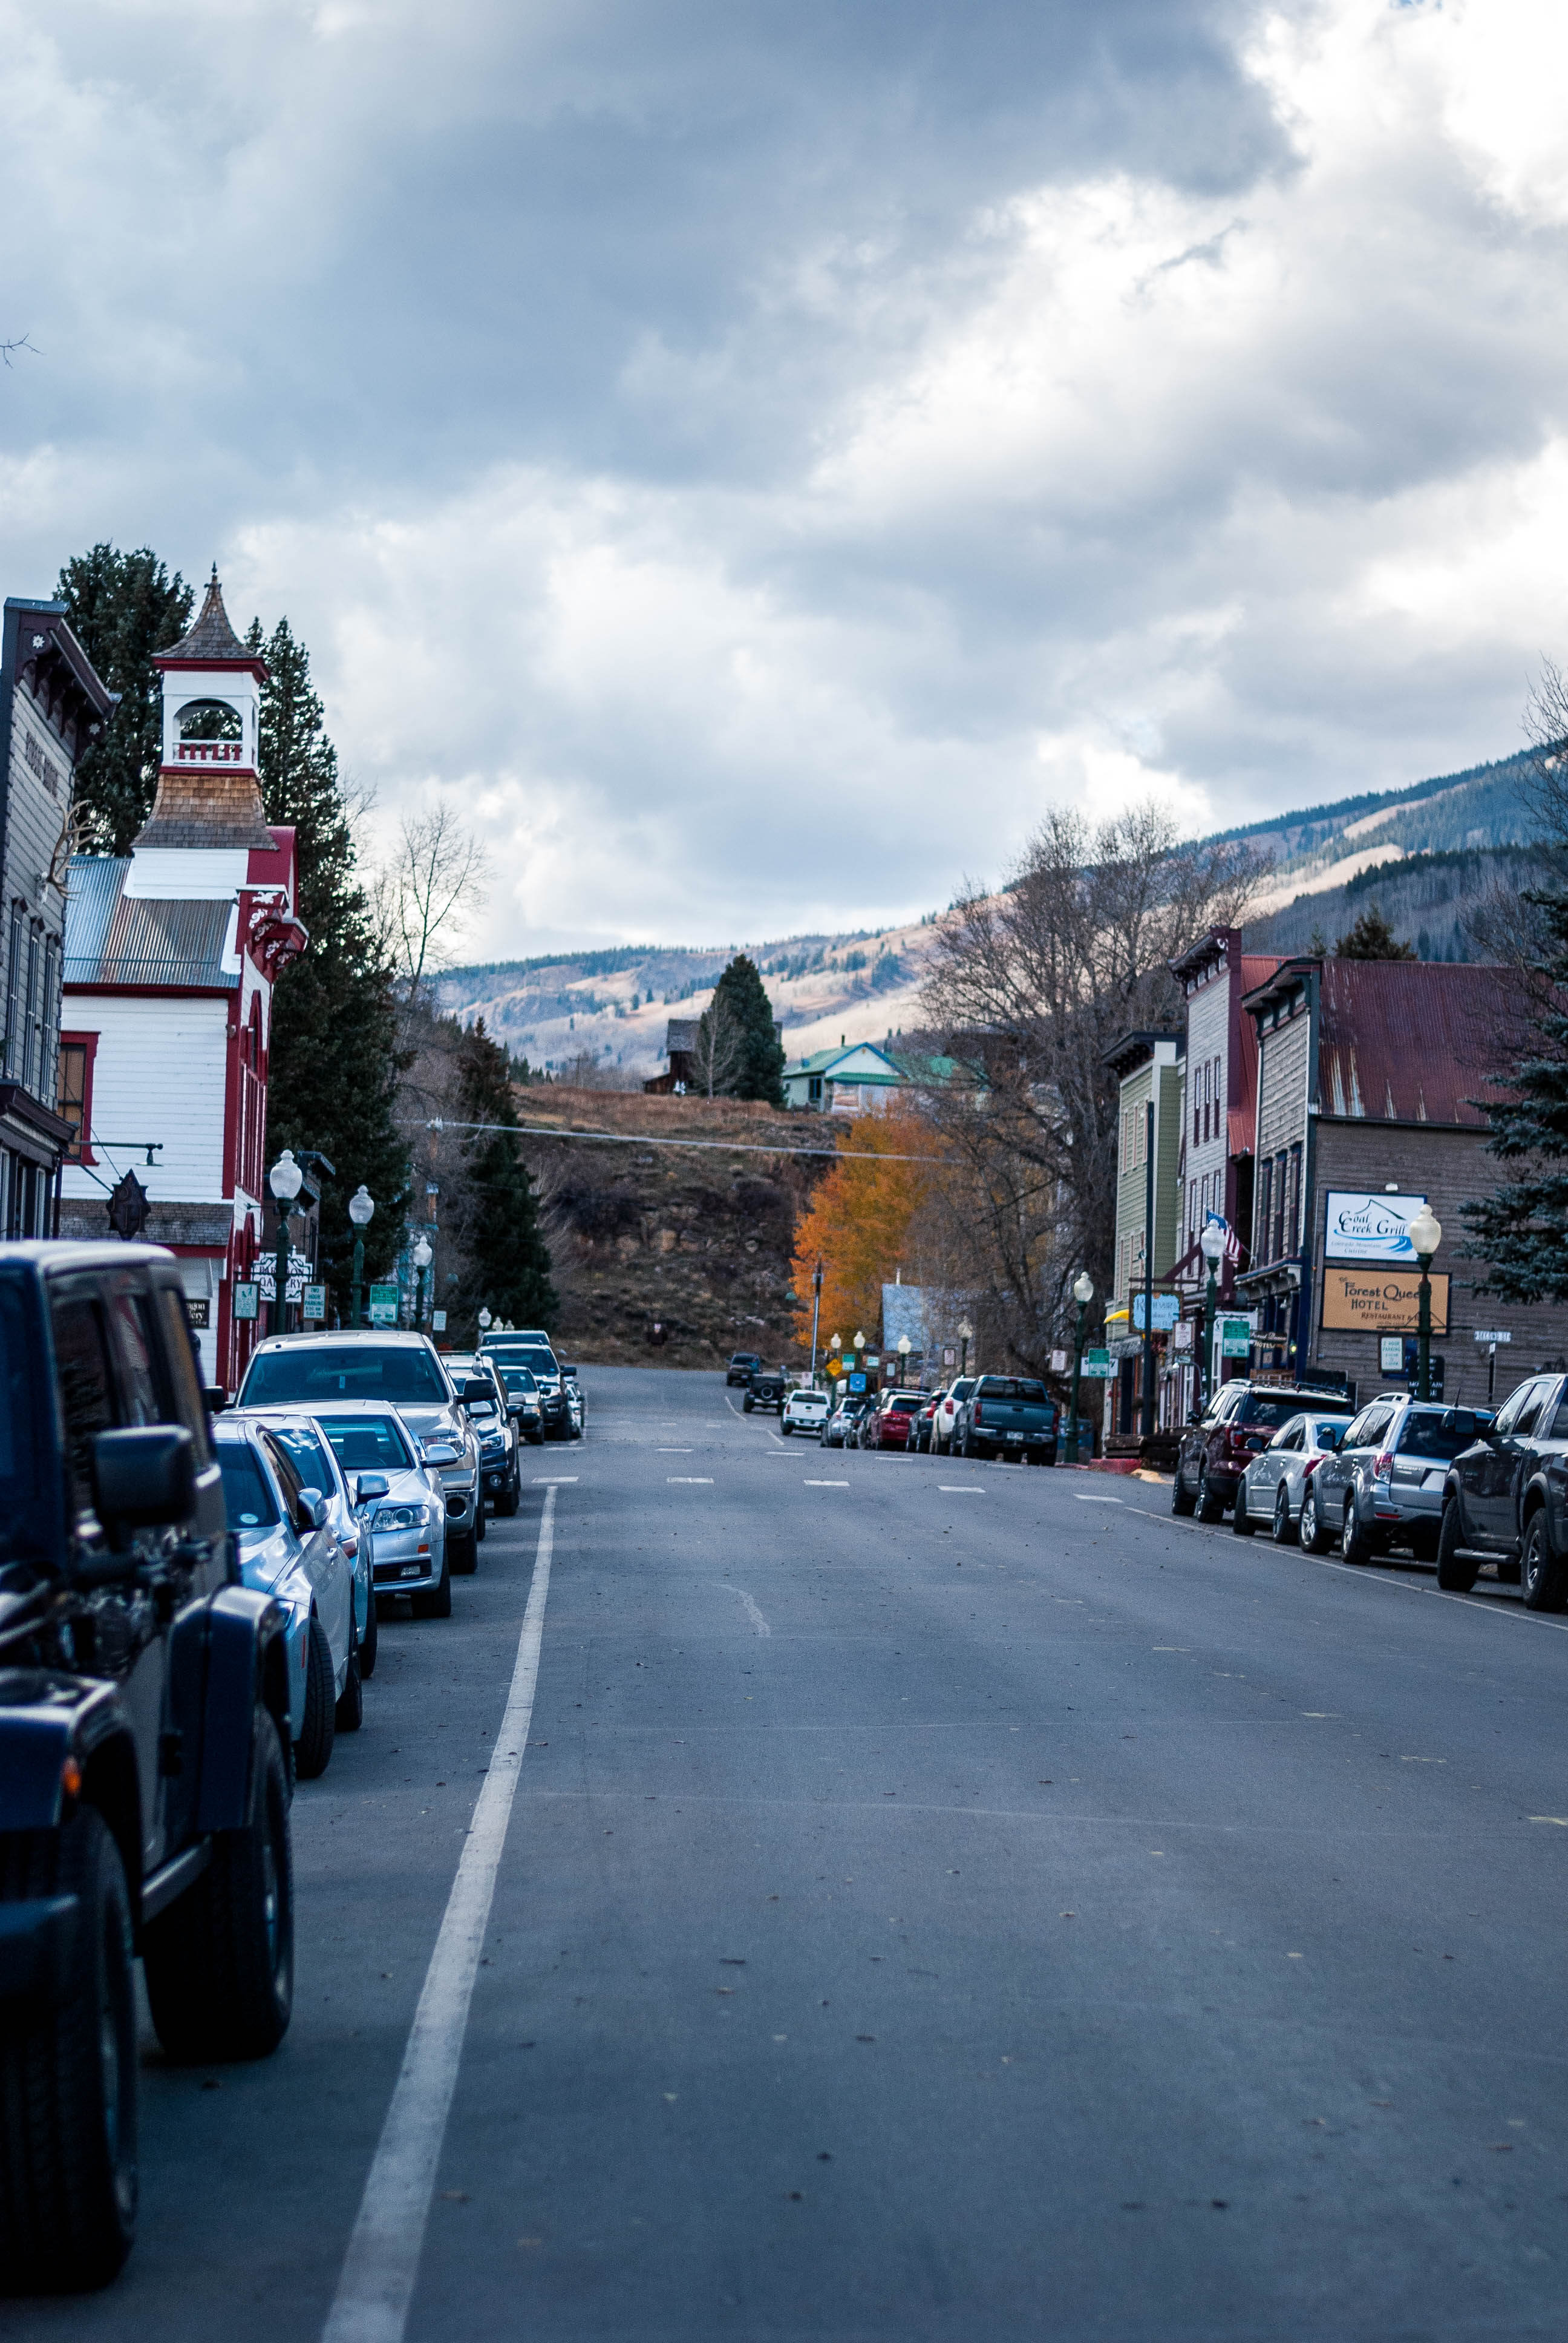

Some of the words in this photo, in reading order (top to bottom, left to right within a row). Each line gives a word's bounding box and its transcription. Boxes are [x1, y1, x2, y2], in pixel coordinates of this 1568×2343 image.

[1339, 1210, 1371, 1224] Coal
[1341, 1217, 1371, 1234] Creek
[1377, 1219, 1408, 1235] Grill
[260, 1265, 304, 1277] PARON
[260, 1277, 302, 1288] GALRY
[1344, 1282, 1380, 1297] Forest
[1383, 1283, 1420, 1302] Quee
[1351, 1299, 1388, 1311] HOTEL
